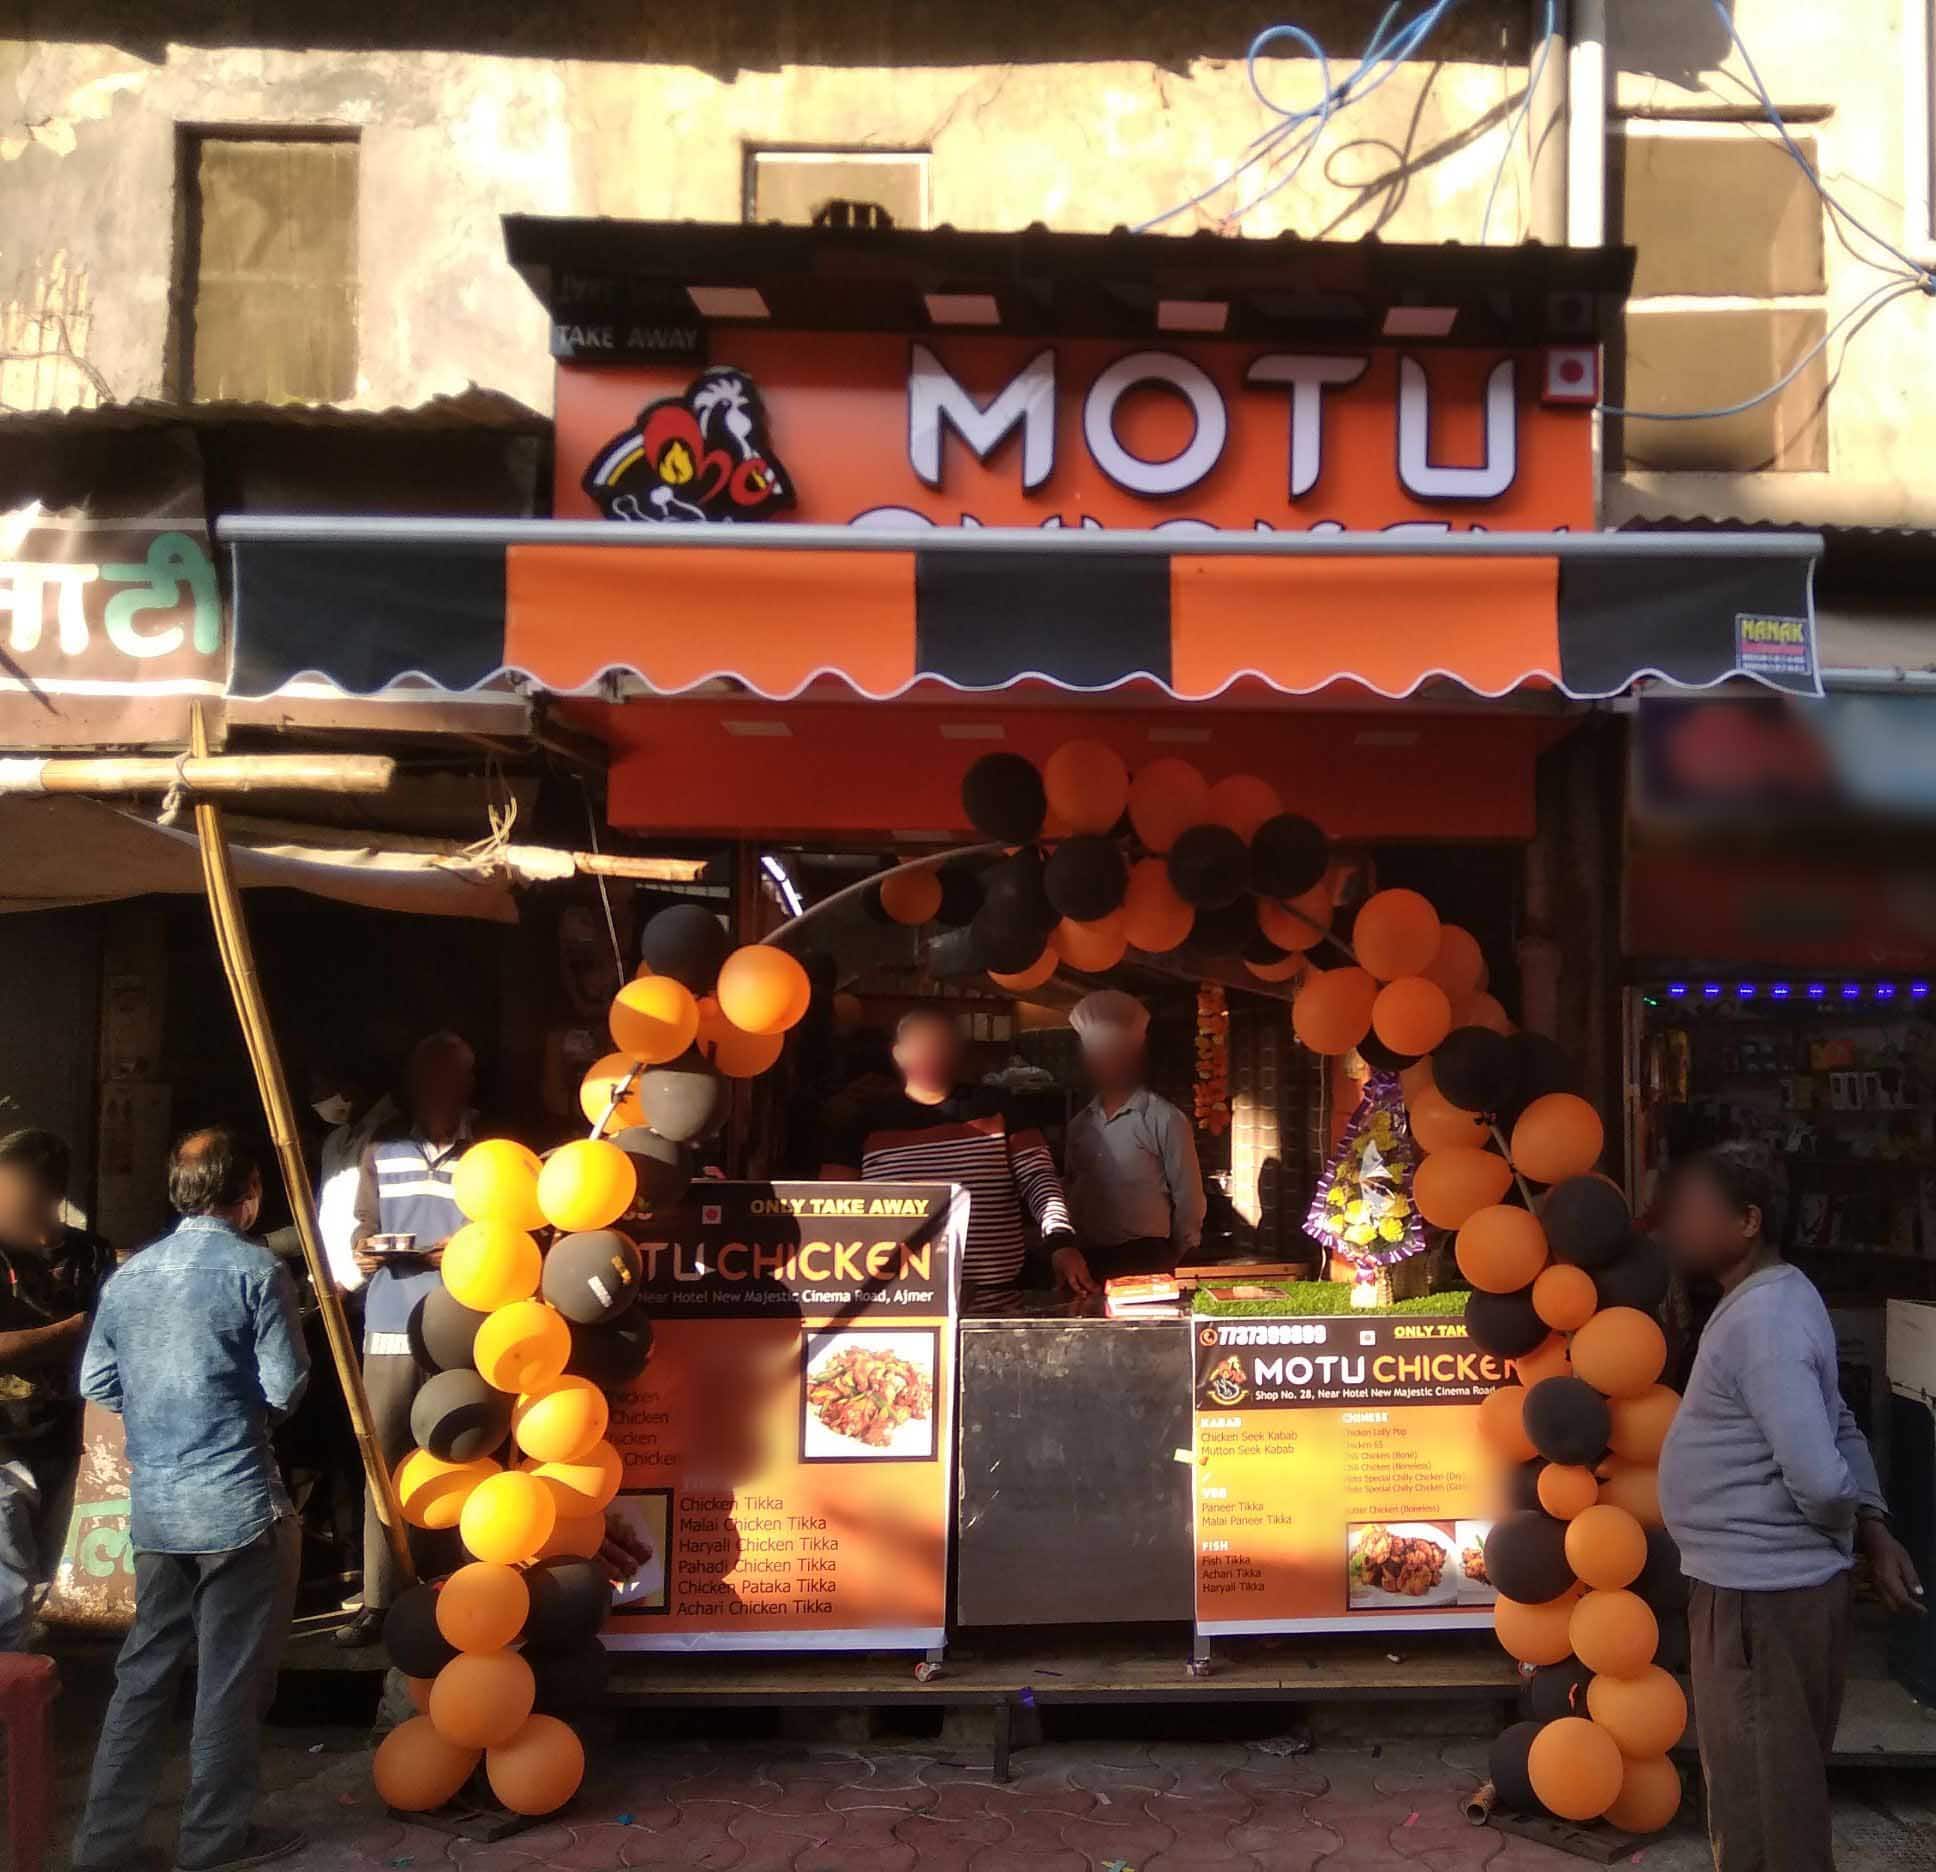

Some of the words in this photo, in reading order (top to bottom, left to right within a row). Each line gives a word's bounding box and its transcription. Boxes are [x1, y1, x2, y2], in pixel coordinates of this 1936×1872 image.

[556, 324, 615, 349] TAKE
[627, 326, 698, 350] AWAY
[911, 343, 1519, 505] MOTU
[751, 1199, 806, 1215] ONLY
[810, 1199, 865, 1215] TAKE
[869, 1198, 929, 1215] AWAY
[639, 1241, 706, 1282] TU
[717, 1240, 932, 1282] CHICKEN
[673, 1290, 708, 1304] Hotel
[712, 1290, 741, 1304] New
[744, 1290, 799, 1306] Majestic
[802, 1289, 852, 1304] Cinema
[855, 1290, 890, 1305] Road,
[894, 1289, 935, 1305] Ajmer
[1394, 1326, 1434, 1338] ONLY
[1438, 1325, 1468, 1337] TAK
[1254, 1355, 1366, 1386] MOTU
[1255, 1390, 1279, 1402] Shop
[1280, 1389, 1297, 1399] No.
[1299, 1389, 1316, 1400] 28,
[1317, 1388, 1341, 1399] Near
[1342, 1387, 1369, 1398] Hotel
[1371, 1387, 1392, 1398] New
[1394, 1386, 1433, 1400] Majestic
[1435, 1385, 1470, 1397] Cinema
[612, 1409, 670, 1424] Chicken
[1201, 1432, 1238, 1443] Chicken
[1242, 1431, 1265, 1442] Seek
[1268, 1430, 1298, 1441] Kabab
[1201, 1446, 1236, 1457] Mutton
[1239, 1445, 1261, 1455] Seek
[1265, 1443, 1295, 1455] Kabab
[680, 1496, 738, 1511] Chicken
[744, 1496, 784, 1510] Tikka
[1202, 1503, 1235, 1513] Paneer
[1239, 1502, 1264, 1512] Tikka
[680, 1517, 719, 1532] Malai
[723, 1516, 782, 1532] Chicken
[787, 1516, 827, 1530] Tikka
[1202, 1516, 1228, 1528] Malai
[1231, 1515, 1263, 1526] Paneer
[1267, 1514, 1292, 1525] Tikka
[679, 1537, 731, 1553] Haryali
[735, 1536, 794, 1552] Chicken
[800, 1536, 839, 1551] Tikka
[1202, 1540, 1230, 1552] FISH
[678, 1559, 728, 1574] Pahadi
[735, 1558, 792, 1573] Chicken
[797, 1557, 837, 1572] Tikka
[1202, 1556, 1222, 1566] Fish
[1226, 1555, 1250, 1565] Tikka
[1202, 1569, 1233, 1580] Achari
[1237, 1568, 1262, 1578] Tikka
[678, 1580, 736, 1595] Chicken
[741, 1579, 791, 1594] Pataka
[797, 1578, 837, 1593] Tikka
[1202, 1583, 1236, 1595] Haryali
[1240, 1582, 1265, 1592] Tikka
[677, 1600, 724, 1616] Achari
[728, 1600, 788, 1615] Chicken
[793, 1600, 833, 1614] Tikka
